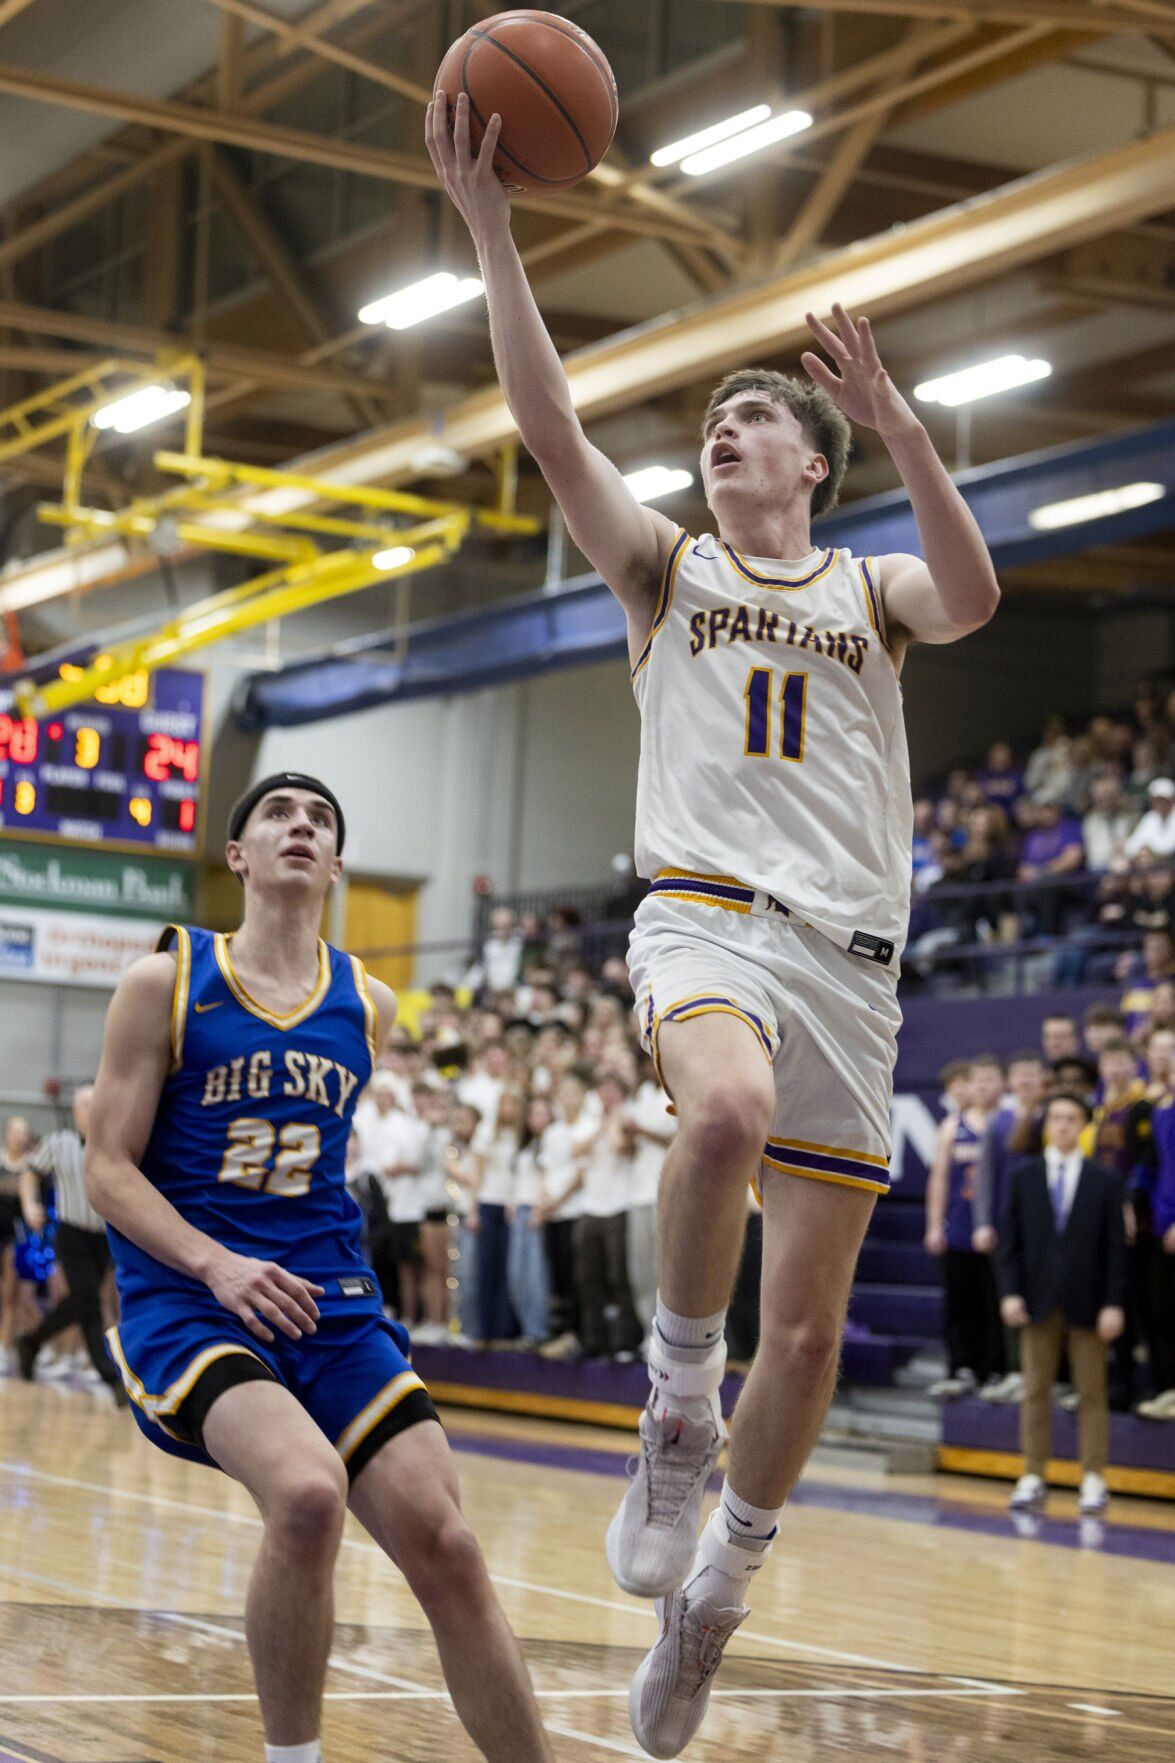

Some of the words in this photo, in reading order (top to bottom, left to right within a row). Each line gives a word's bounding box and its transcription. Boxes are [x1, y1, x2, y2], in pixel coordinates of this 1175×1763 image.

[689, 605, 868, 675] SPARTANS
[743, 666, 808, 763] 11
[144, 732, 199, 782] 24
[201, 1050, 272, 1107] BIG
[283, 1050, 359, 1119] SKY
[217, 1117, 321, 1198] 22
